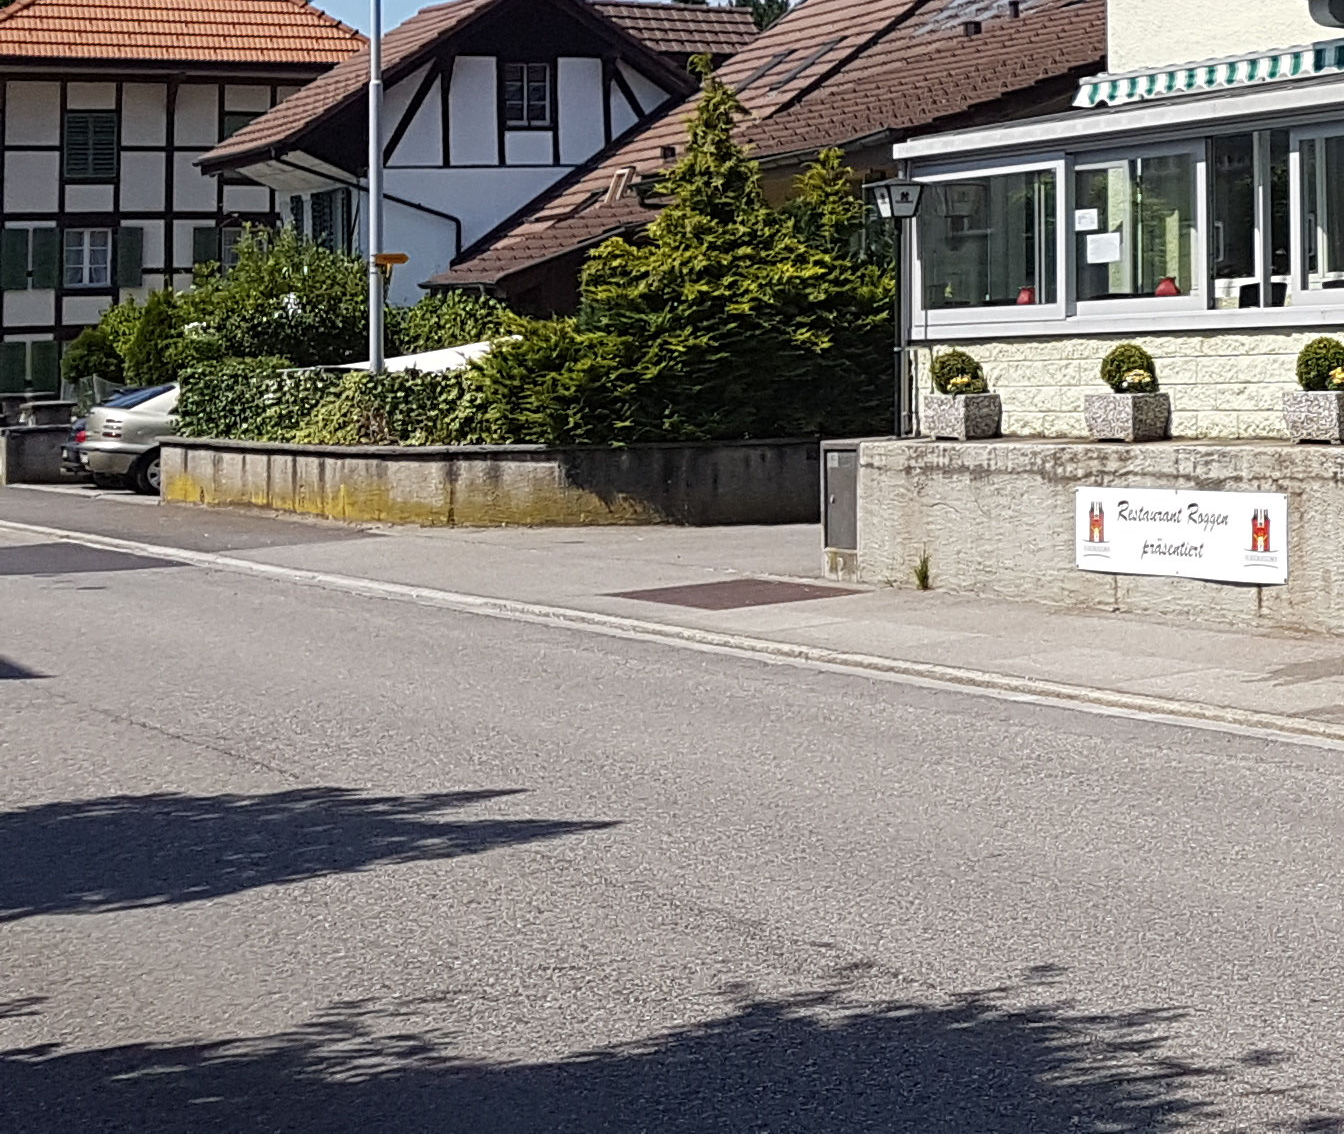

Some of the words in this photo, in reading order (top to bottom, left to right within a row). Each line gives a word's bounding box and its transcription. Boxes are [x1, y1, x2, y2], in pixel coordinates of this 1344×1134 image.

[1117, 500, 1183, 523] Restaurant
[1187, 503, 1229, 532] Roggen
[1141, 538, 1204, 559] präsentiert
